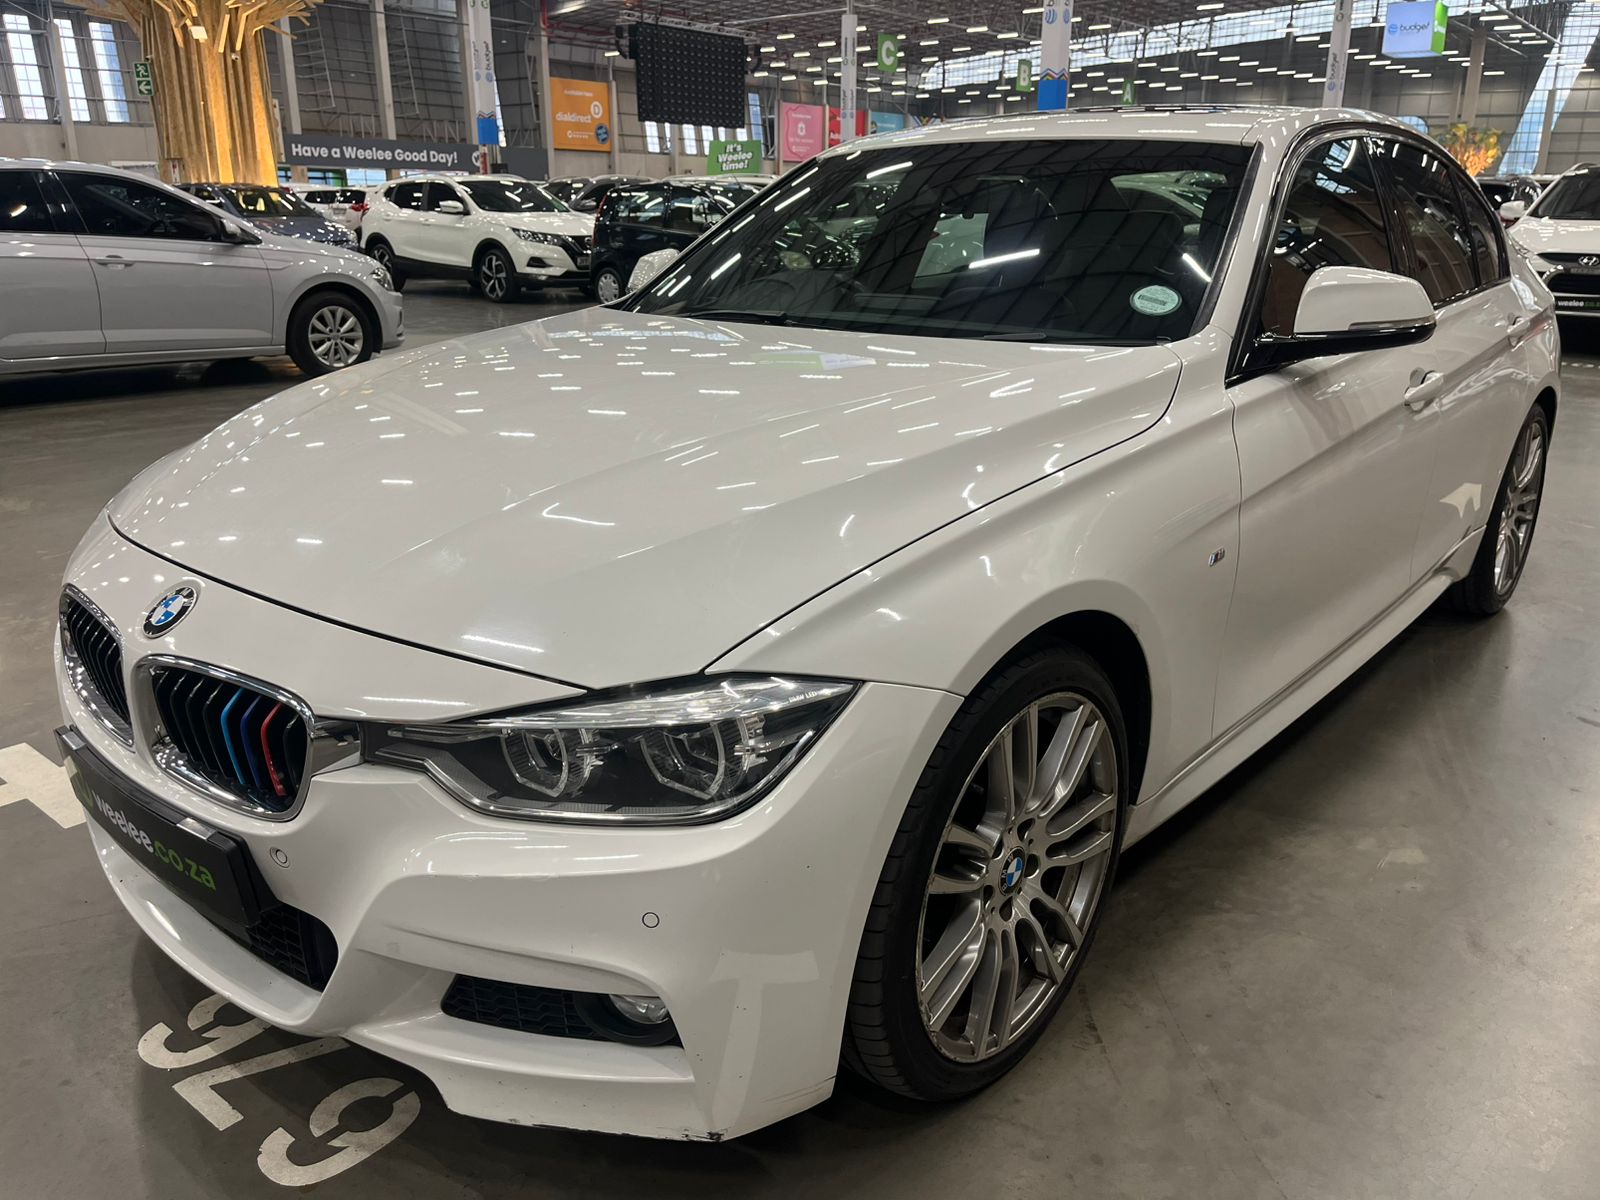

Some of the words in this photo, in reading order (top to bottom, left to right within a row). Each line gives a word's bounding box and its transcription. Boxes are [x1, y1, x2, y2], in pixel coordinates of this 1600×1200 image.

[1399, 22, 1430, 33] budget
[881, 40, 896, 66] C
[1020, 64, 1029, 87] B
[1123, 82, 1132, 102] A
[291, 143, 333, 158] Have
[331, 148, 341, 159] a
[343, 146, 392, 161] Weelee
[394, 149, 427, 162] Good
[430, 151, 458, 167] Day!
[725, 143, 742, 153] It's
[717, 152, 753, 163] Weelee
[722, 160, 748, 171] time!
